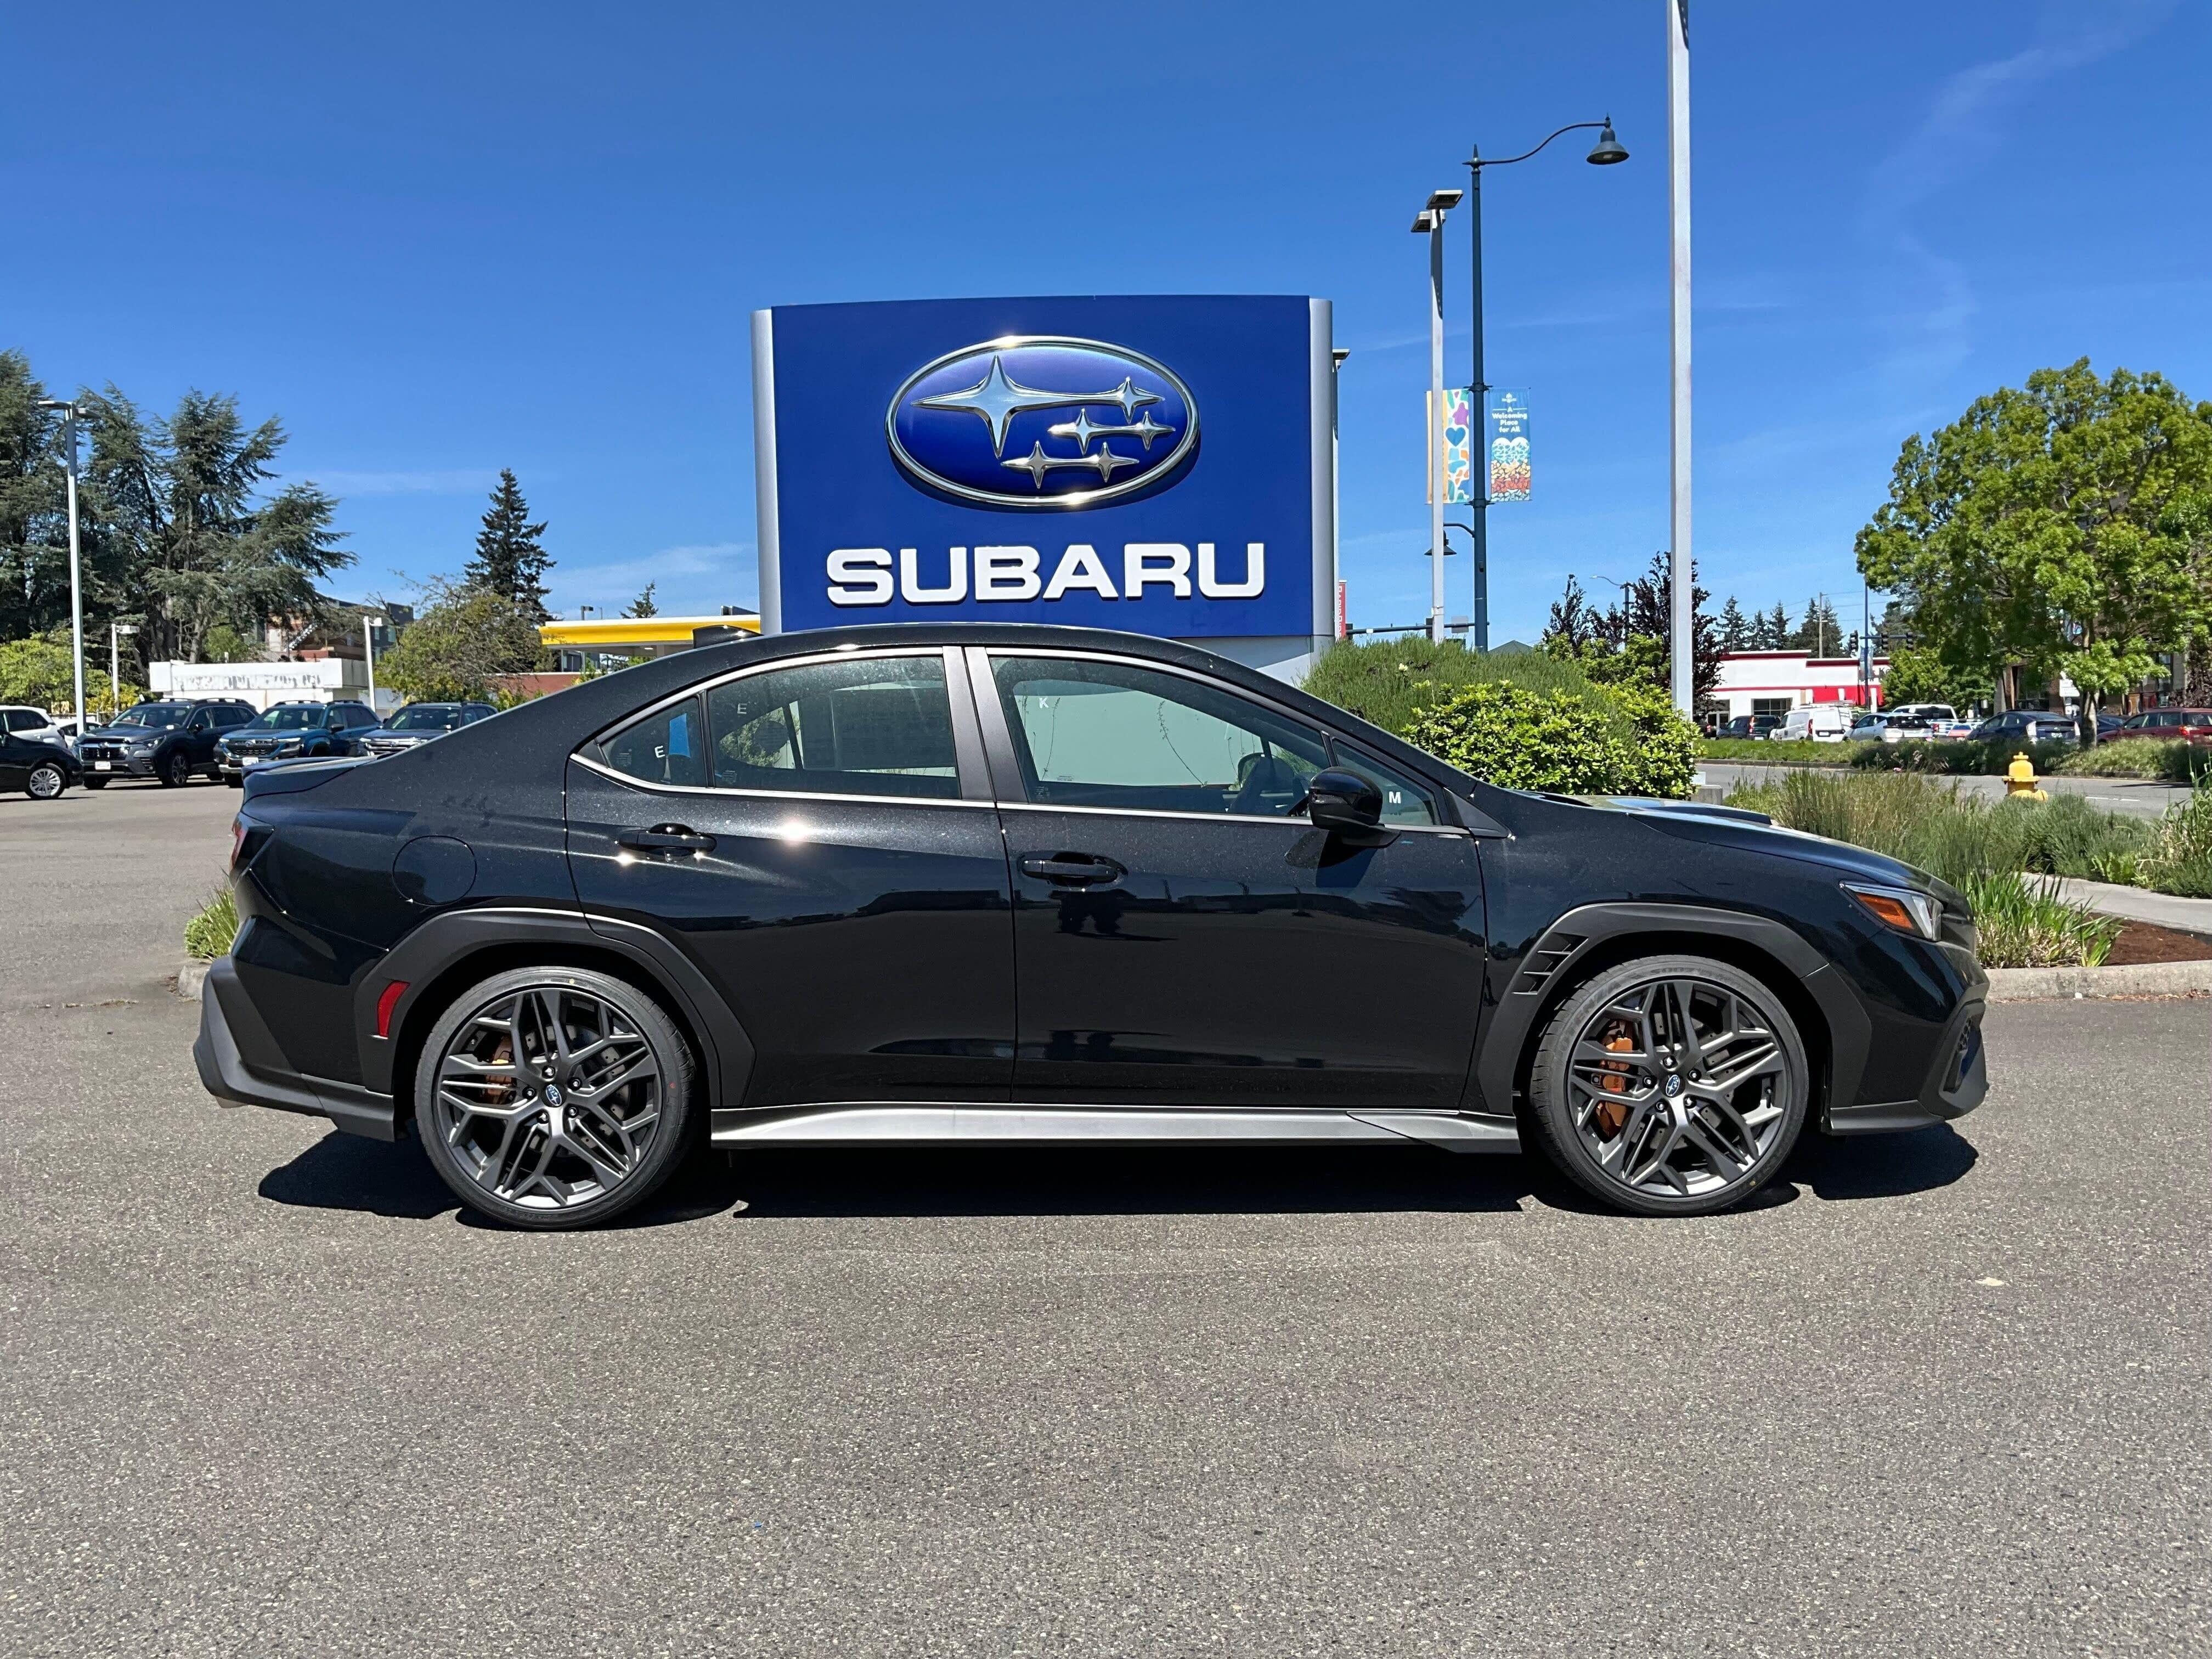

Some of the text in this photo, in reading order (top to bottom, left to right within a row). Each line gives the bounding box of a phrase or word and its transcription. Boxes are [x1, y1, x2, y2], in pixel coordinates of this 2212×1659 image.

[827, 543, 1265, 605] SUBARU
[737, 703, 747, 714] E
[1040, 697, 1049, 708] K
[654, 745, 665, 758] E
[1389, 791, 1401, 804] M
